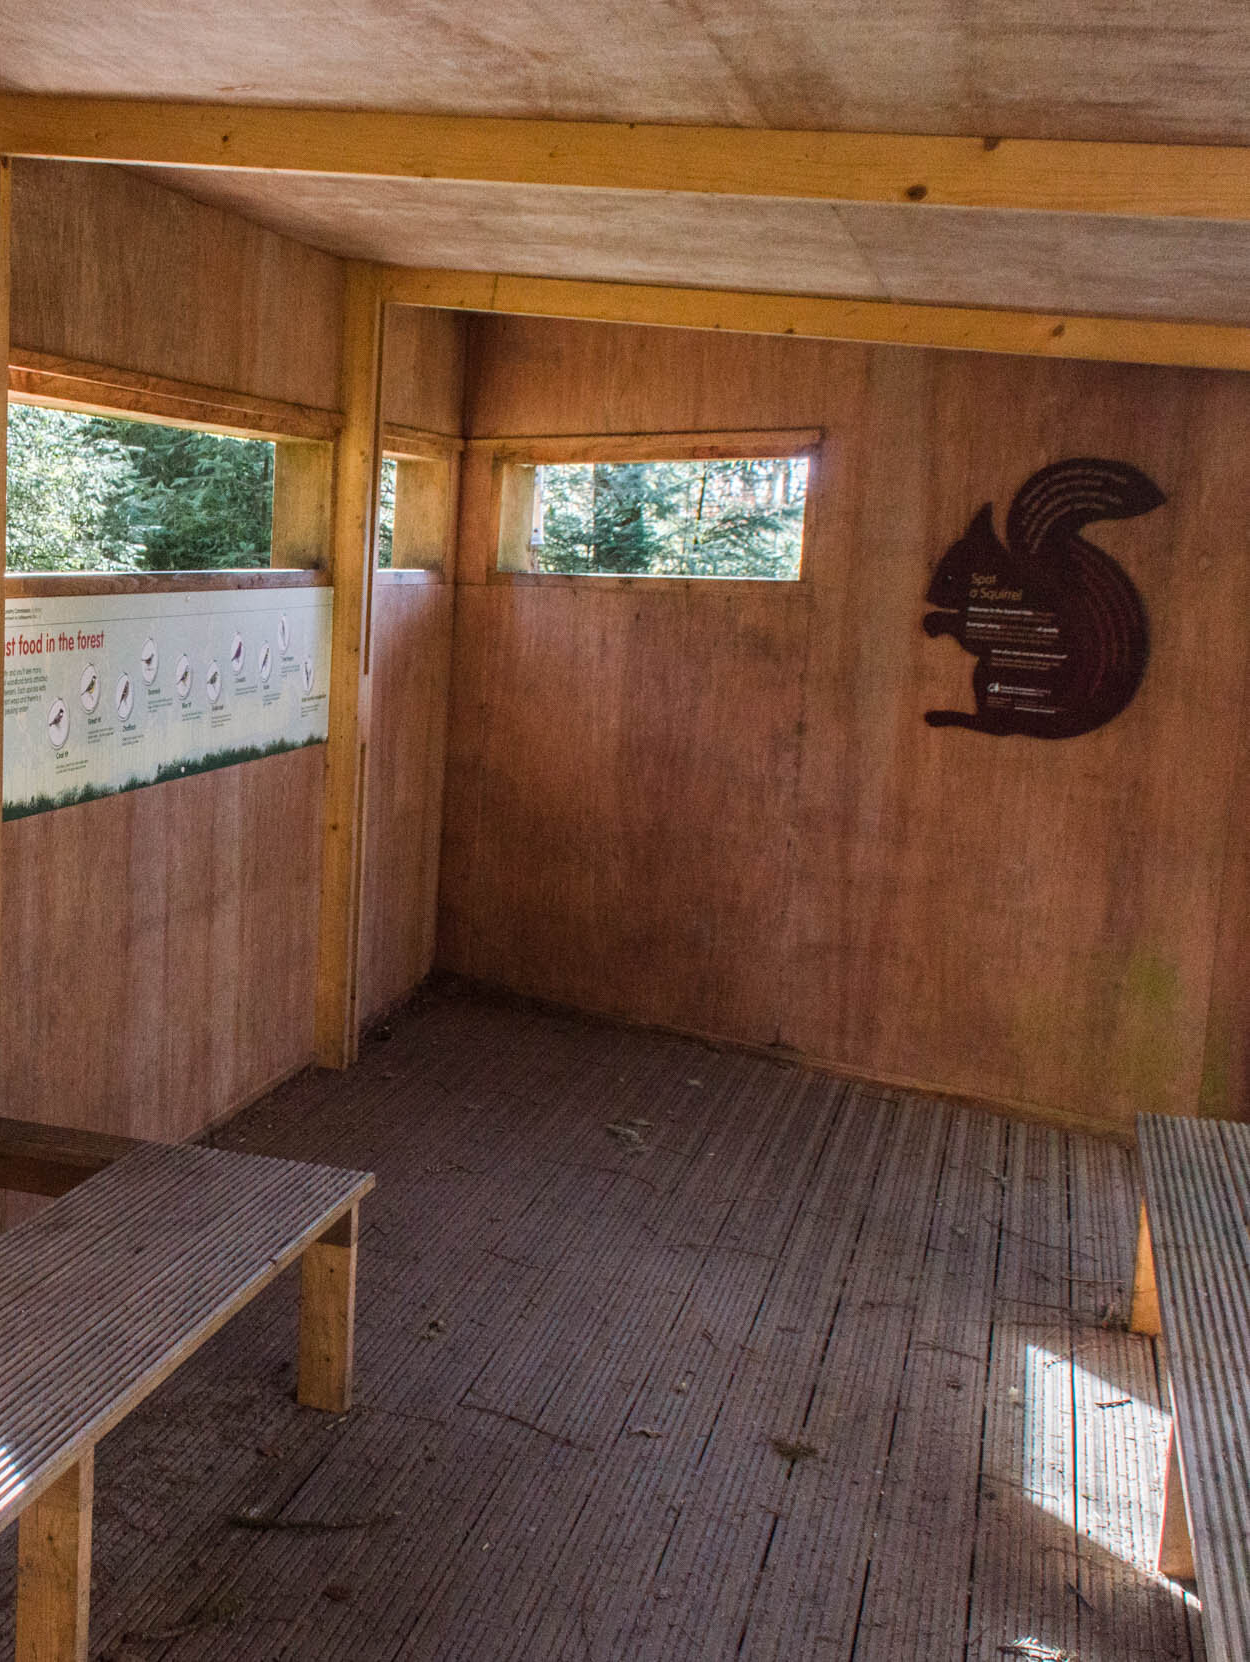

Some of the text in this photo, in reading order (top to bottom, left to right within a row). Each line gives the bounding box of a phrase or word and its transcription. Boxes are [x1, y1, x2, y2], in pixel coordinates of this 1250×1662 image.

[971, 573, 997, 586] Spot
[980, 587, 1023, 601] Squirrel
[4, 628, 105, 657] st food in the forest
